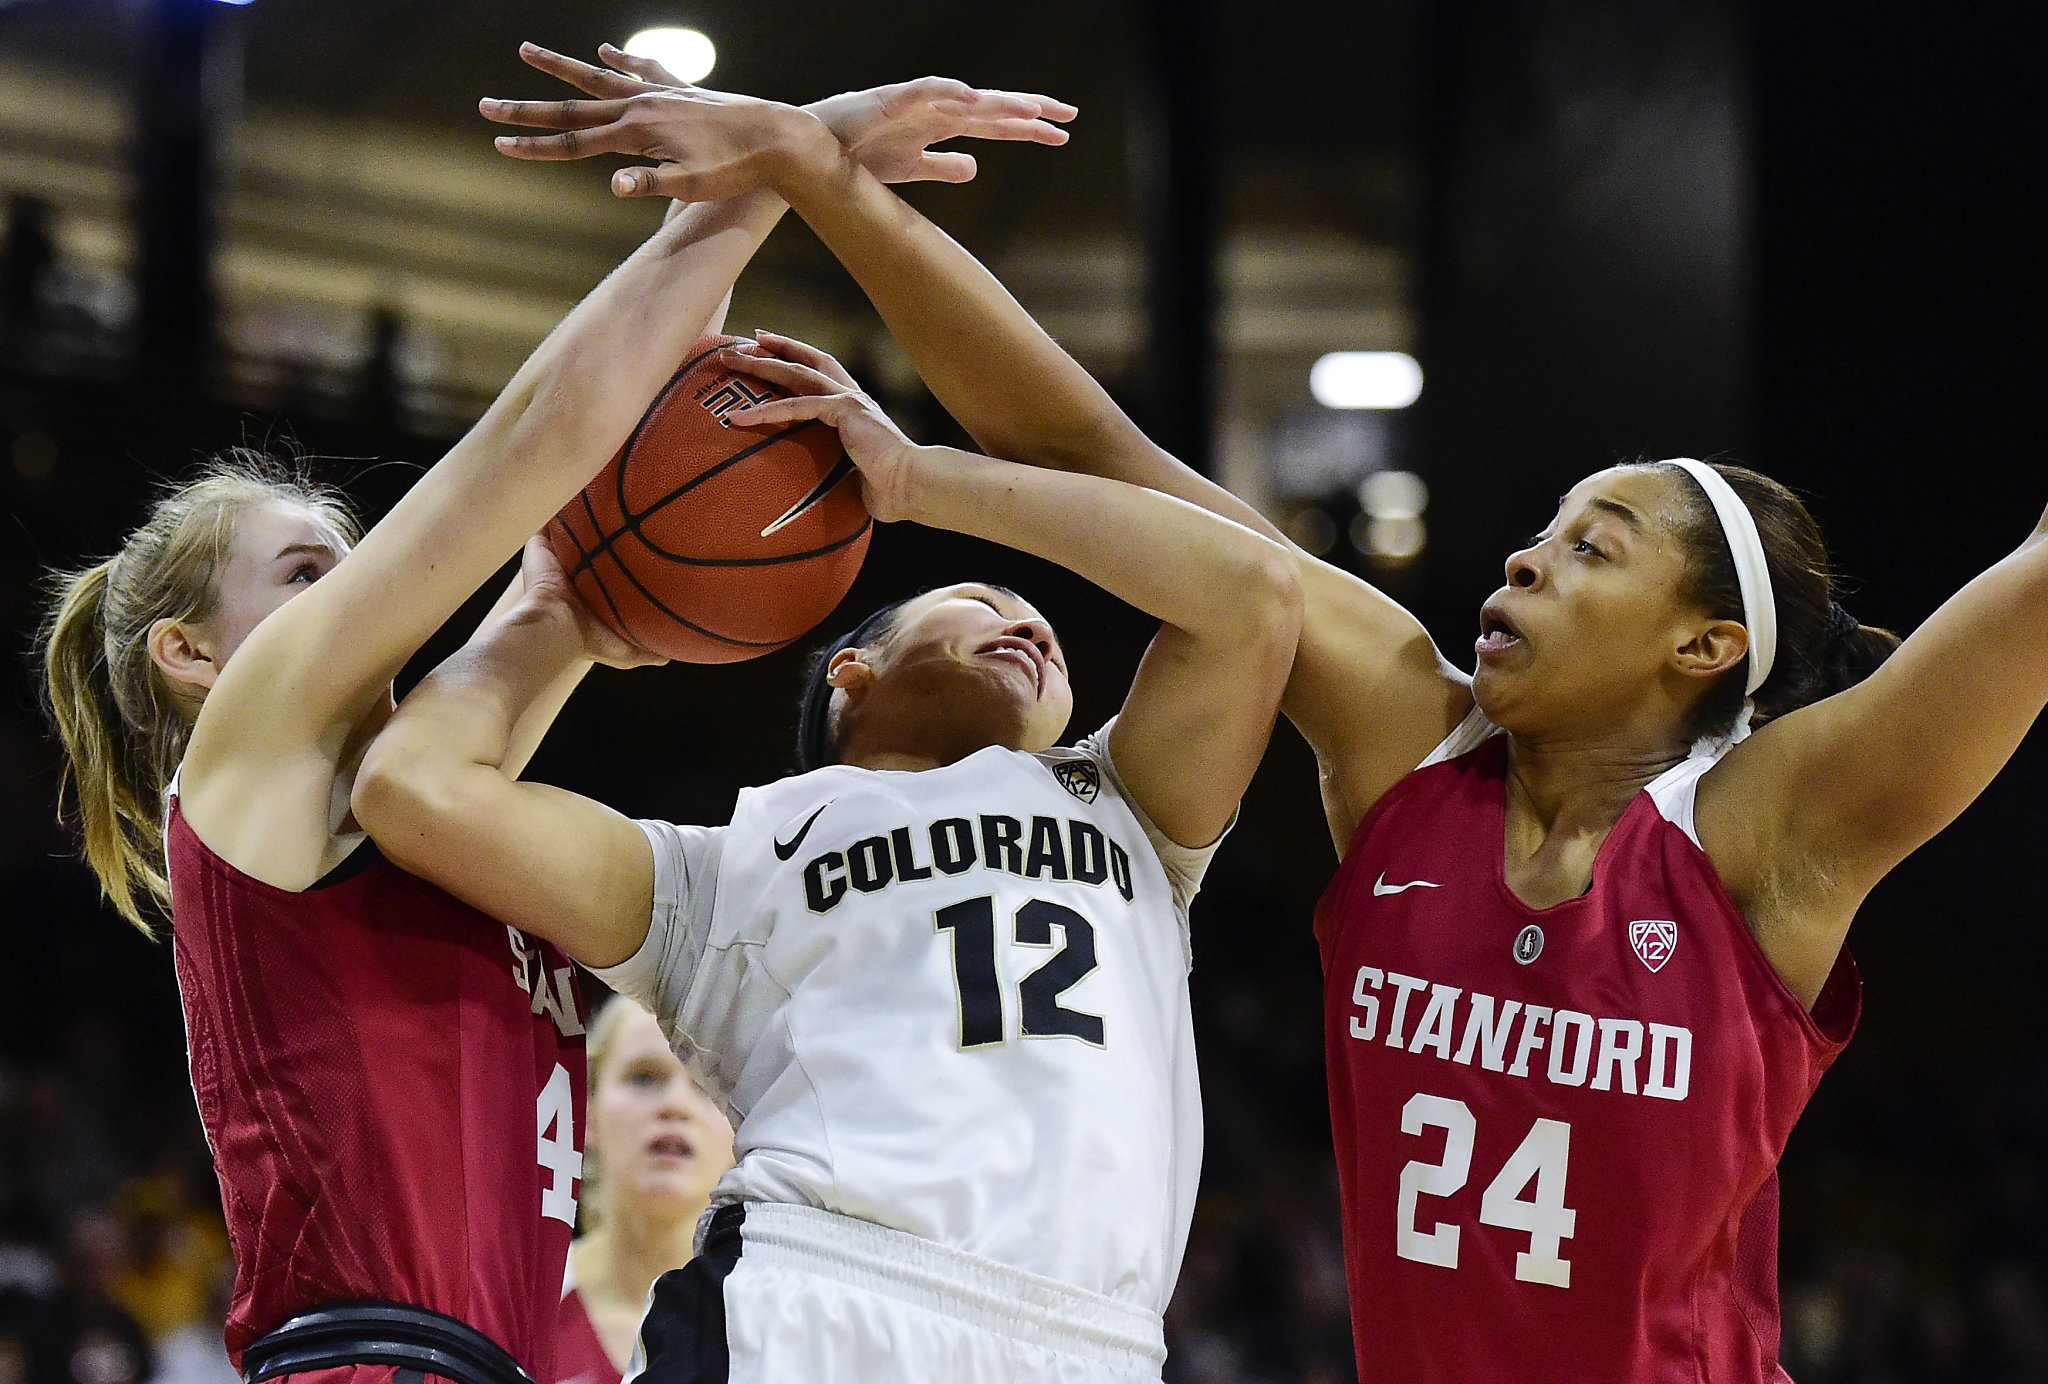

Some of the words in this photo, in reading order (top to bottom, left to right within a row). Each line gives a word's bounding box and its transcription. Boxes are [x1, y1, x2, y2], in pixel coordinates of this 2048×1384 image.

[802, 813, 1135, 915] COLORADO
[933, 894, 1107, 1053] 12
[1633, 923, 1674, 949] PAC
[1643, 942, 1665, 959] 12
[1349, 966, 1693, 1101] STANFORD
[1396, 1092, 1577, 1289] 24
